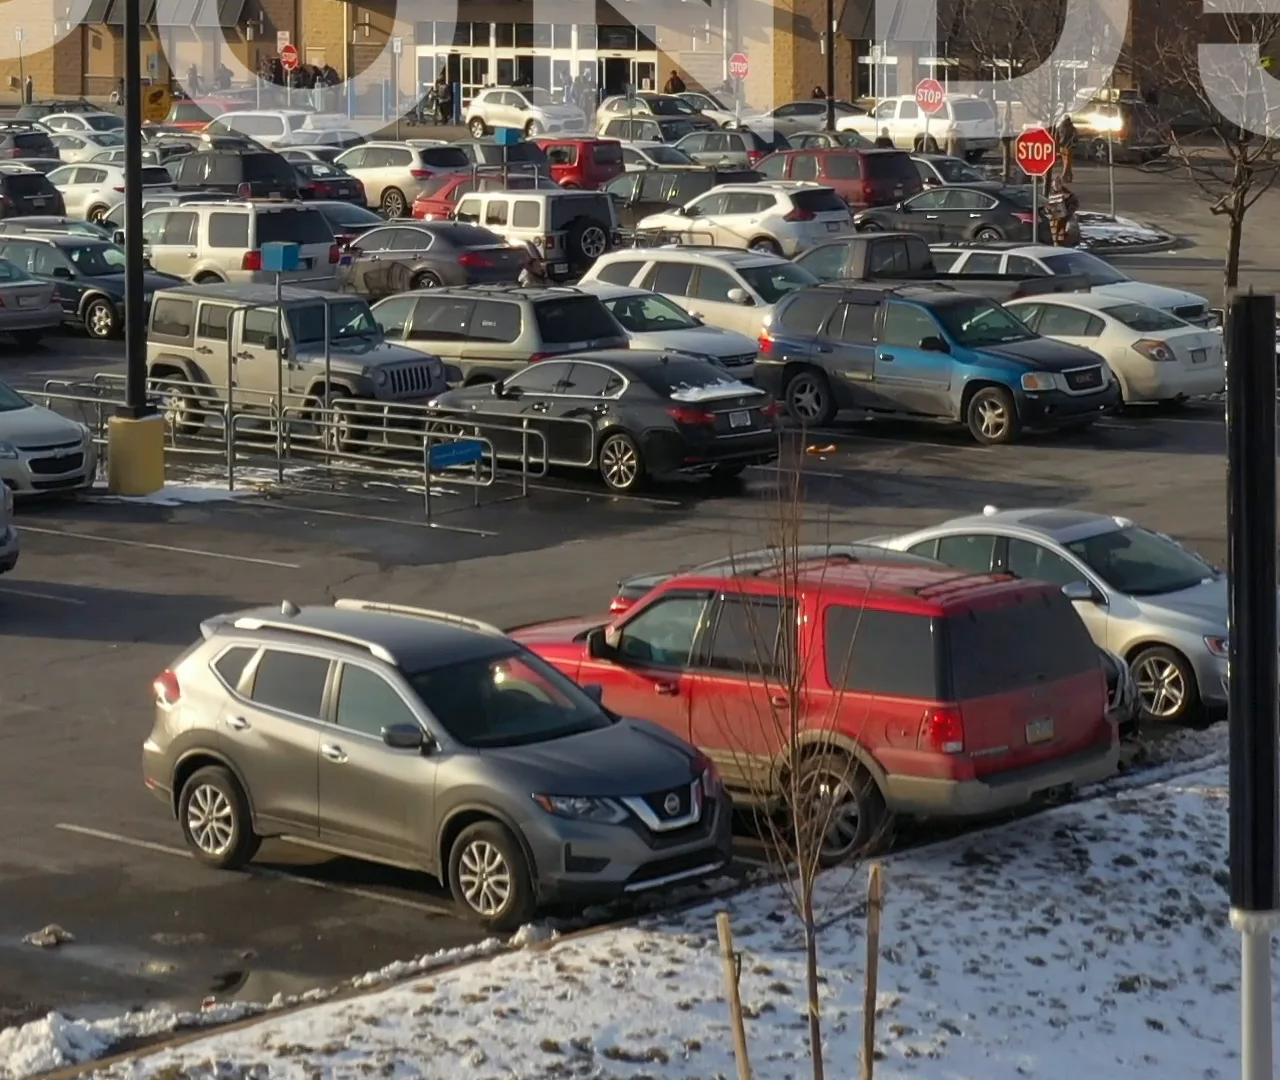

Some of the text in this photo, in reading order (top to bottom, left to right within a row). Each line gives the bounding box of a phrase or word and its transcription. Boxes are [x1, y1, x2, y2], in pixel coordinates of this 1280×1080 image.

[730, 61, 748, 72] STOP
[917, 88, 941, 104] STOP
[1018, 142, 1052, 160] STOP
